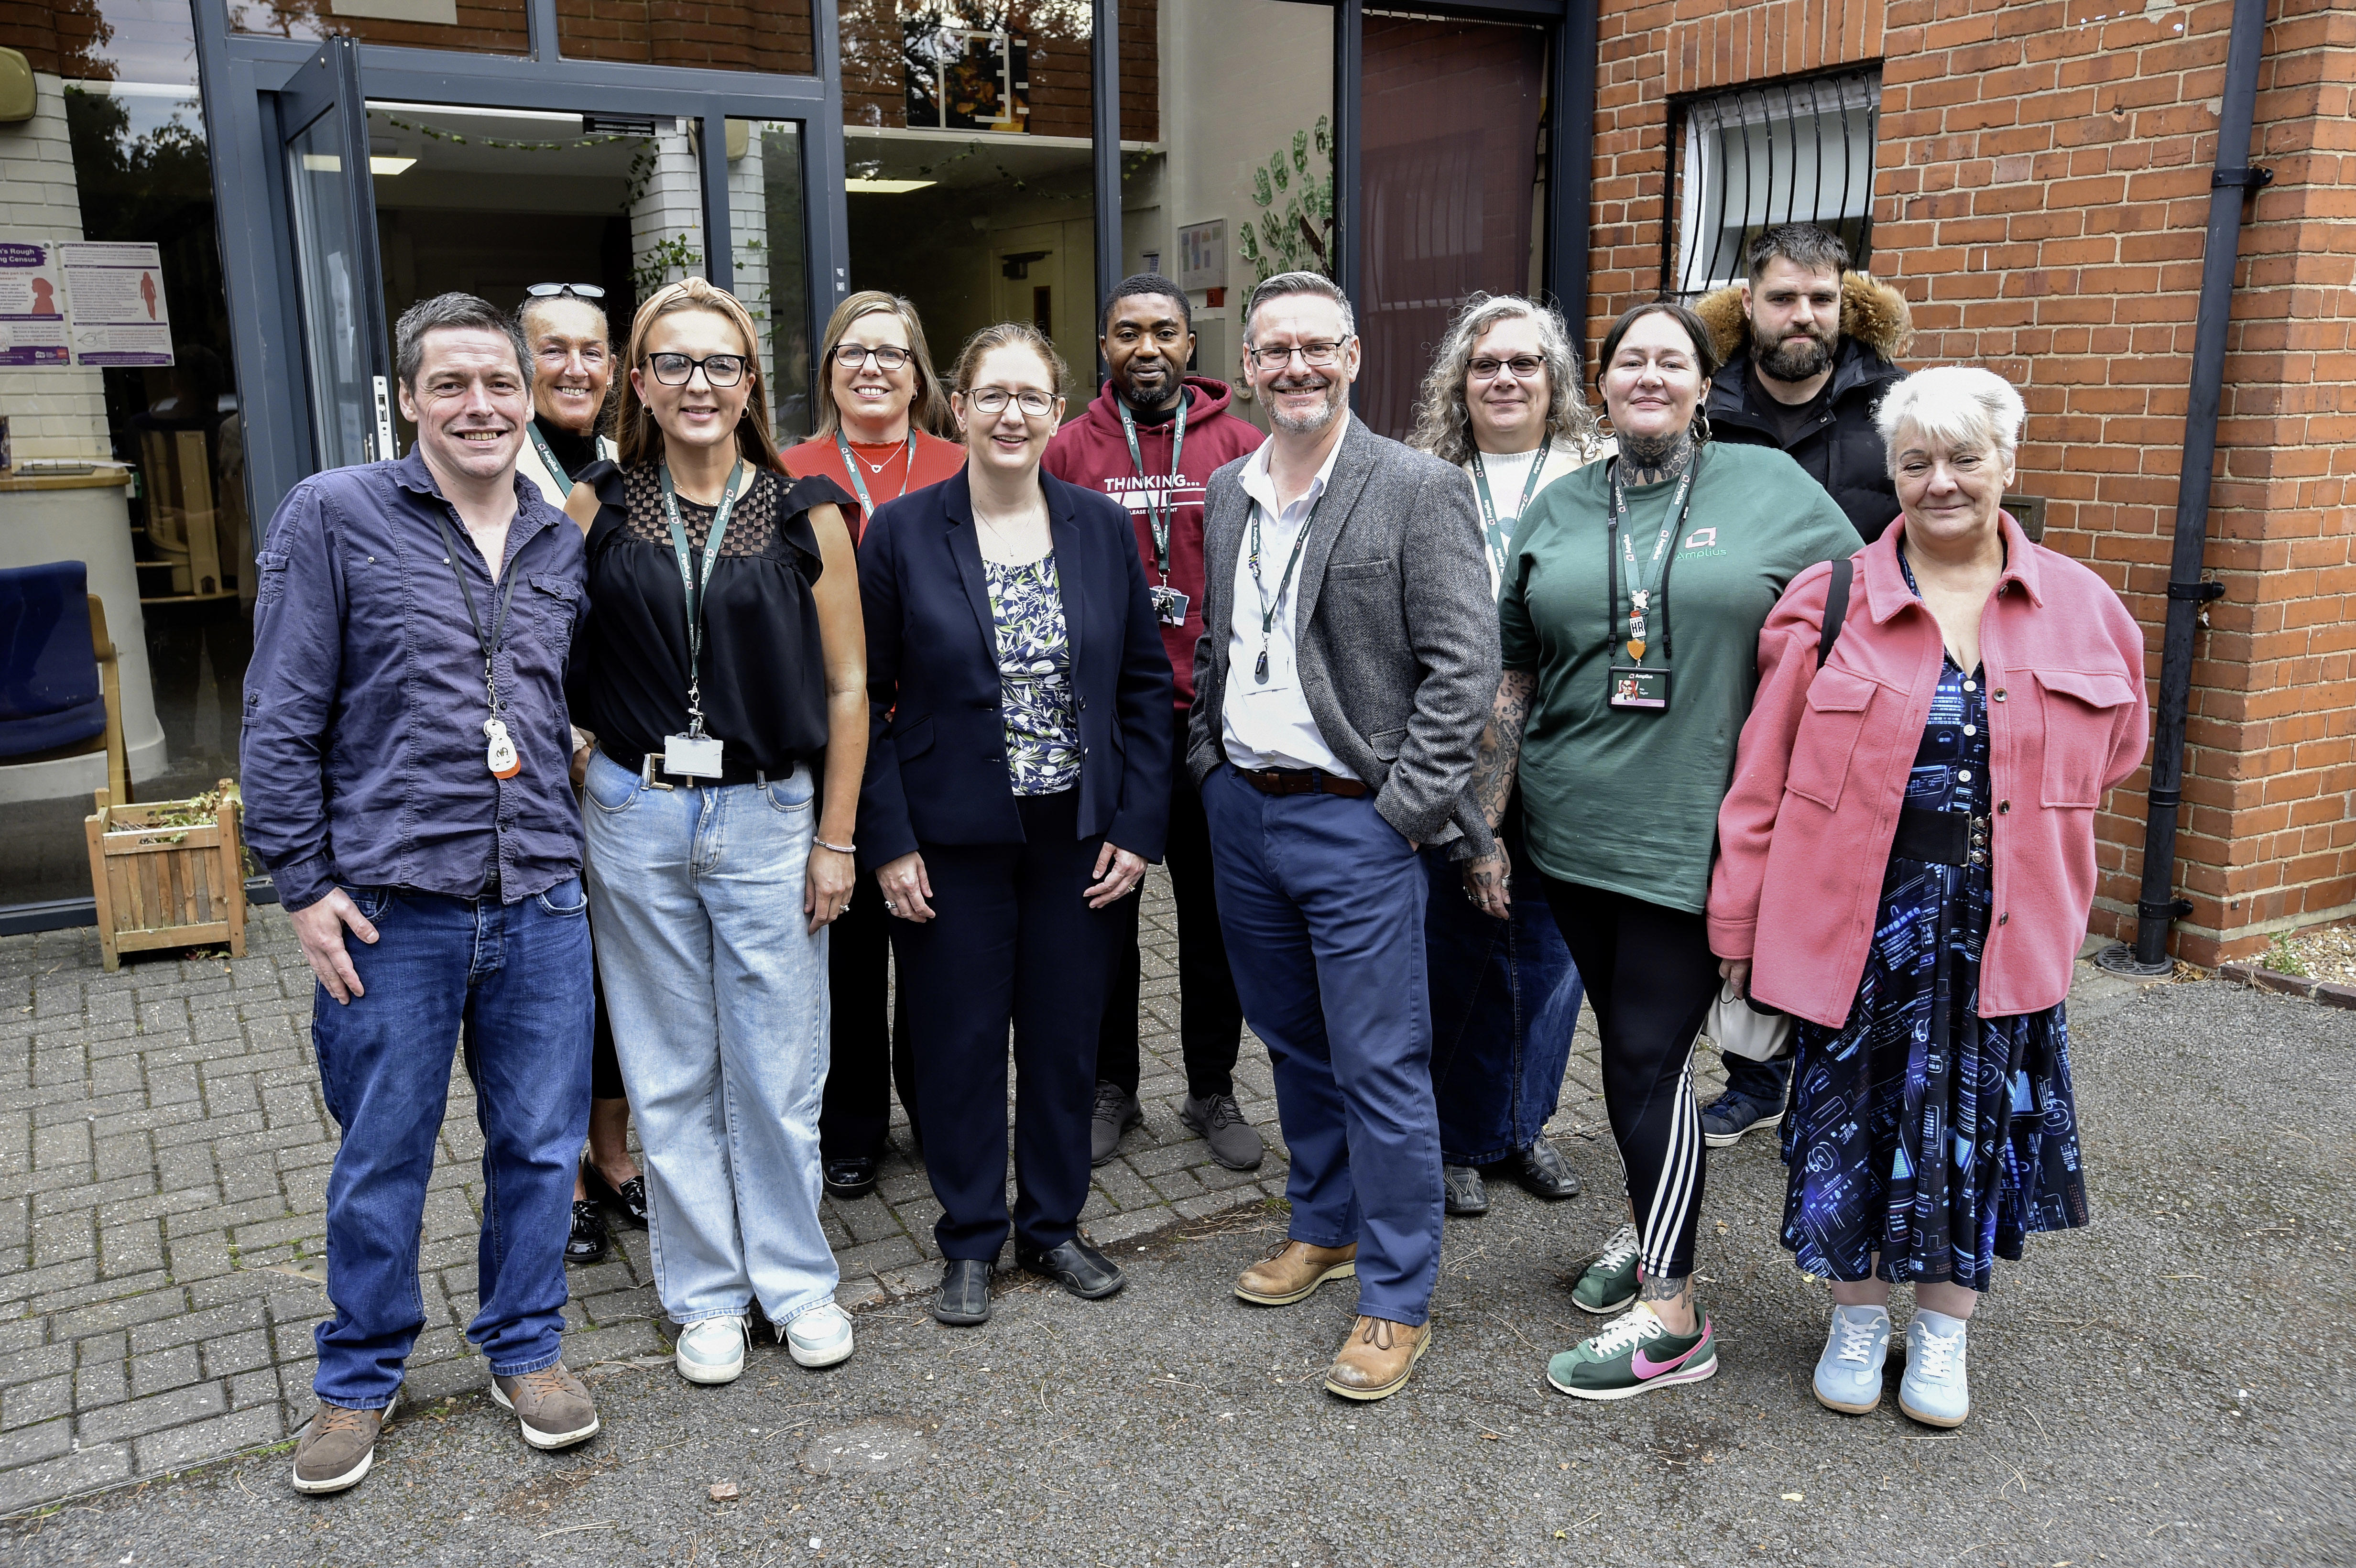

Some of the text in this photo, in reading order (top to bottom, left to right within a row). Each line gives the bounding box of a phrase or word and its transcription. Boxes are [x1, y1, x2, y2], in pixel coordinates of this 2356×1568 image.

[1126, 425, 1135, 445] Amplius
[543, 451, 559, 472] Amplius
[1104, 474, 1200, 491] THINKING...
[666, 492, 676, 515] Amplius
[1674, 483, 1687, 505] Amplius
[719, 497, 732, 521] Amplius
[1299, 515, 1312, 540] Amplius
[1652, 538, 1667, 560] Amplius
[1675, 548, 1726, 560] Amplius
[681, 553, 691, 579] Amplius
[701, 558, 712, 584] Amplius
[1631, 621, 1644, 634] HR
[496, 747, 508, 758] NA
